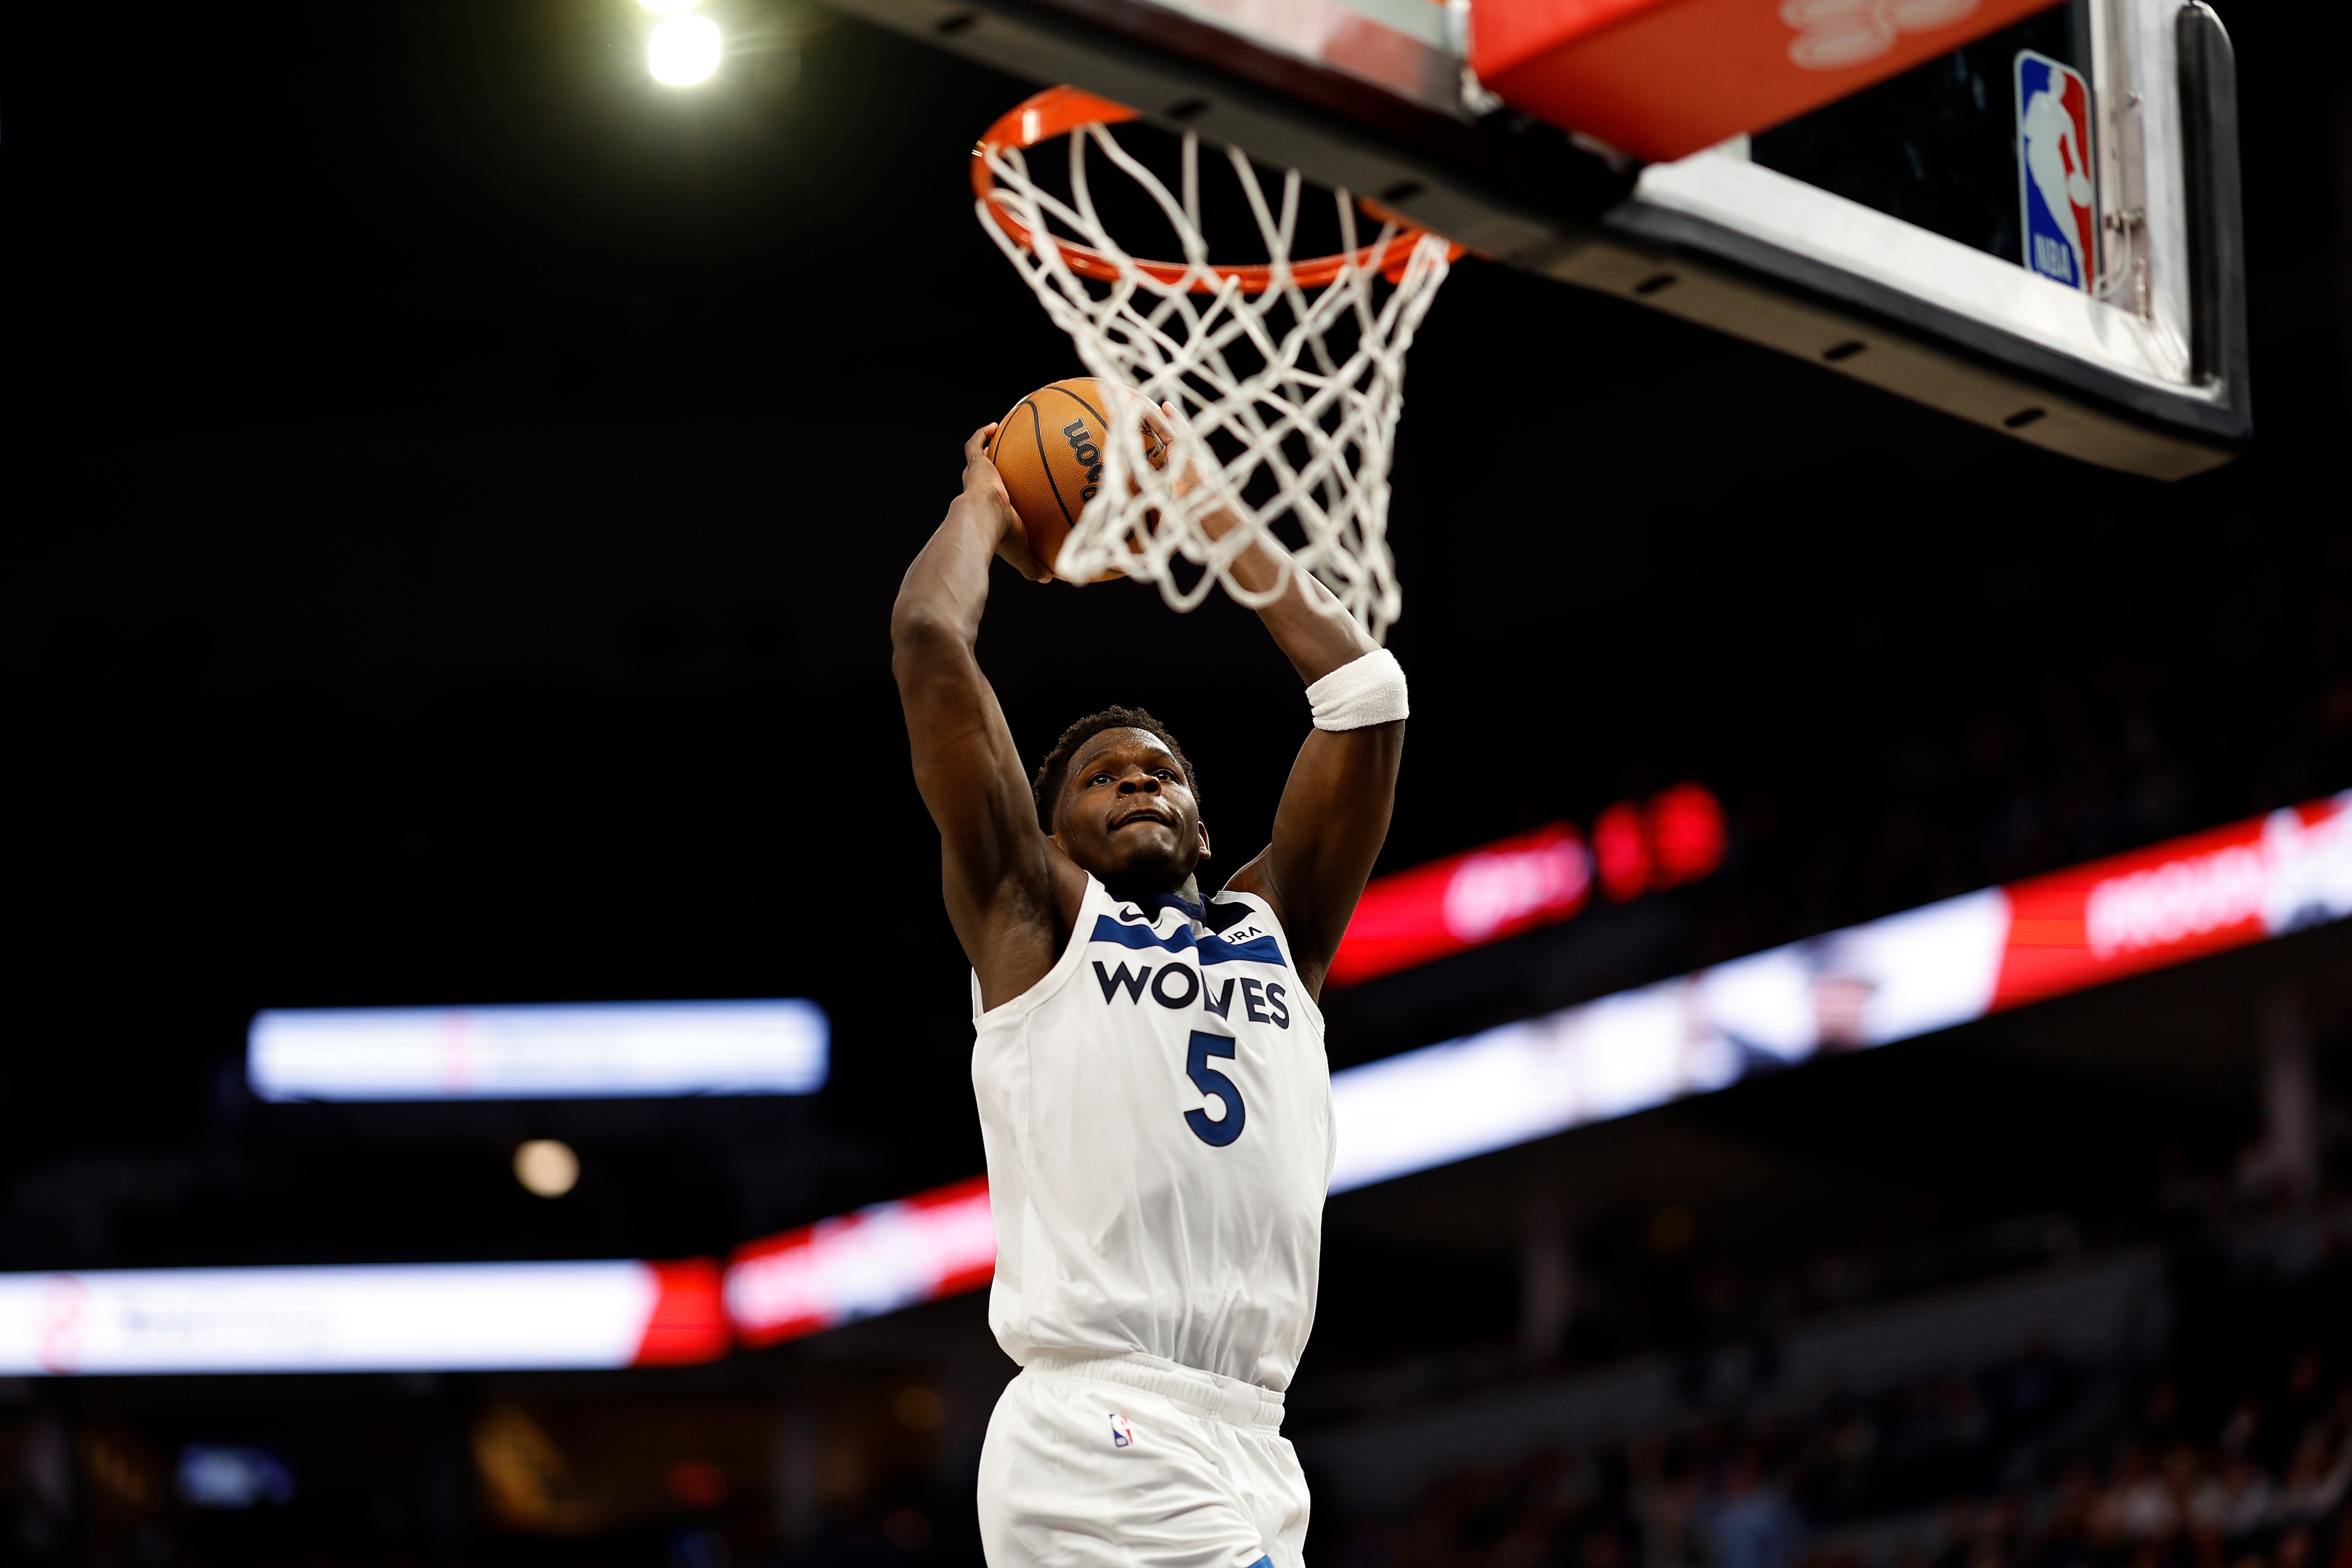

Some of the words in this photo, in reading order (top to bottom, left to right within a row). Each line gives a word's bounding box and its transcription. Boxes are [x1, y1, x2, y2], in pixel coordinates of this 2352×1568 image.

[2034, 233, 2073, 282] NBA
[1092, 961, 1289, 1029] WOLVES
[1184, 1029, 1246, 1147] 5
